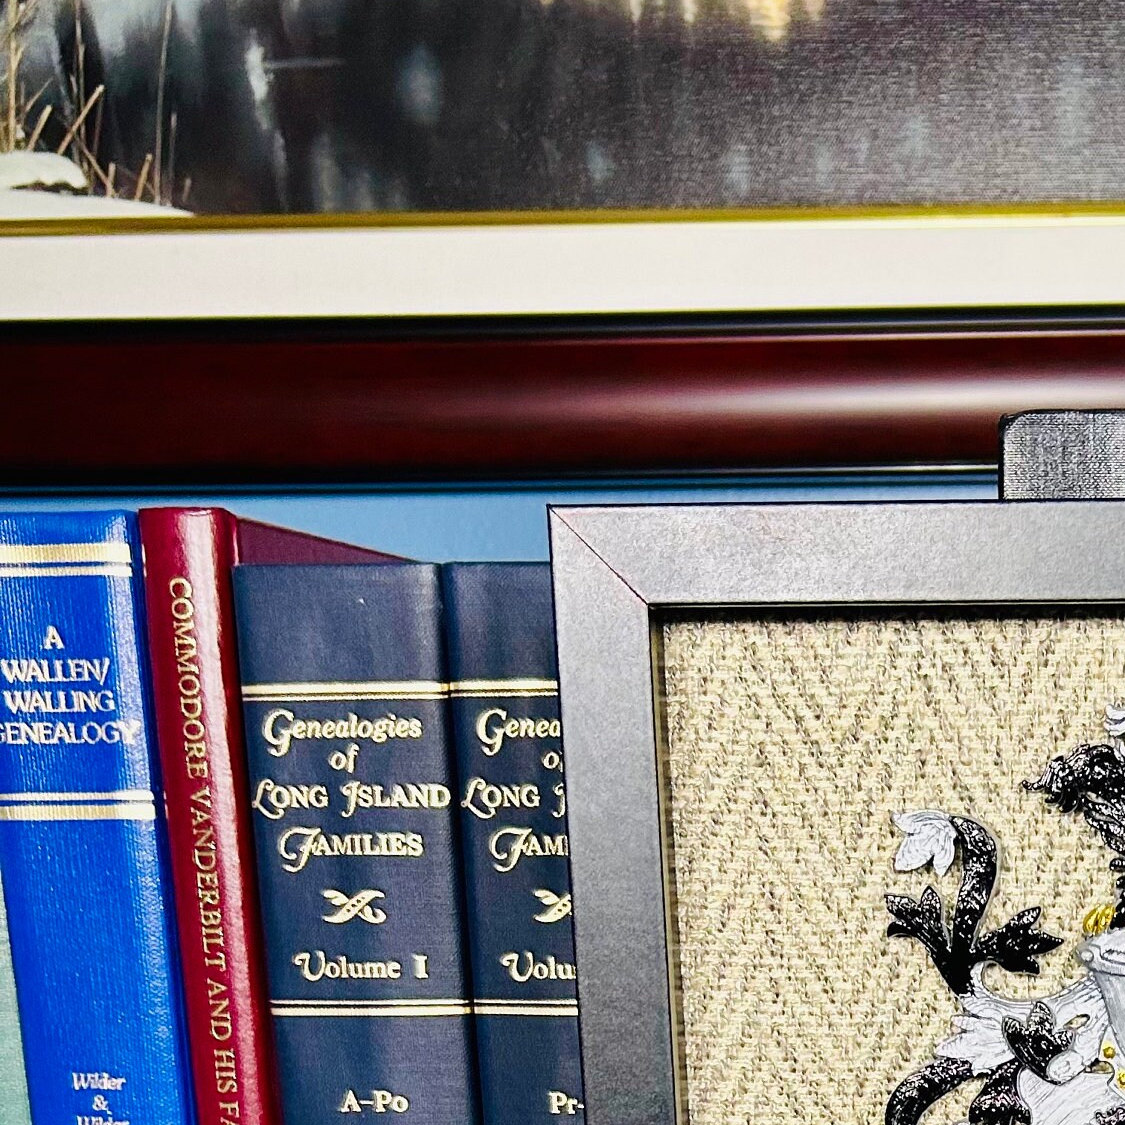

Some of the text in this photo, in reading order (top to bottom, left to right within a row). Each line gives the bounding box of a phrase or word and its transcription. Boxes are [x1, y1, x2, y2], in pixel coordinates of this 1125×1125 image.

[43, 624, 65, 651] A
[0, 656, 111, 686] WALLEN/
[168, 576, 209, 780] COMMODORE
[2, 689, 116, 715] WALLING
[262, 707, 423, 757] Genealogies
[328, 742, 360, 774] of
[189, 784, 227, 972] VANDERBILT
[293, 950, 429, 982] Volume I
[206, 977, 233, 1042] AND
[72, 1072, 127, 1091] Wilder
[213, 1048, 238, 1094] HIS
[92, 1094, 110, 1112] &
[338, 1089, 410, 1113] A-Po
[548, 1090, 585, 1115] Pr-
